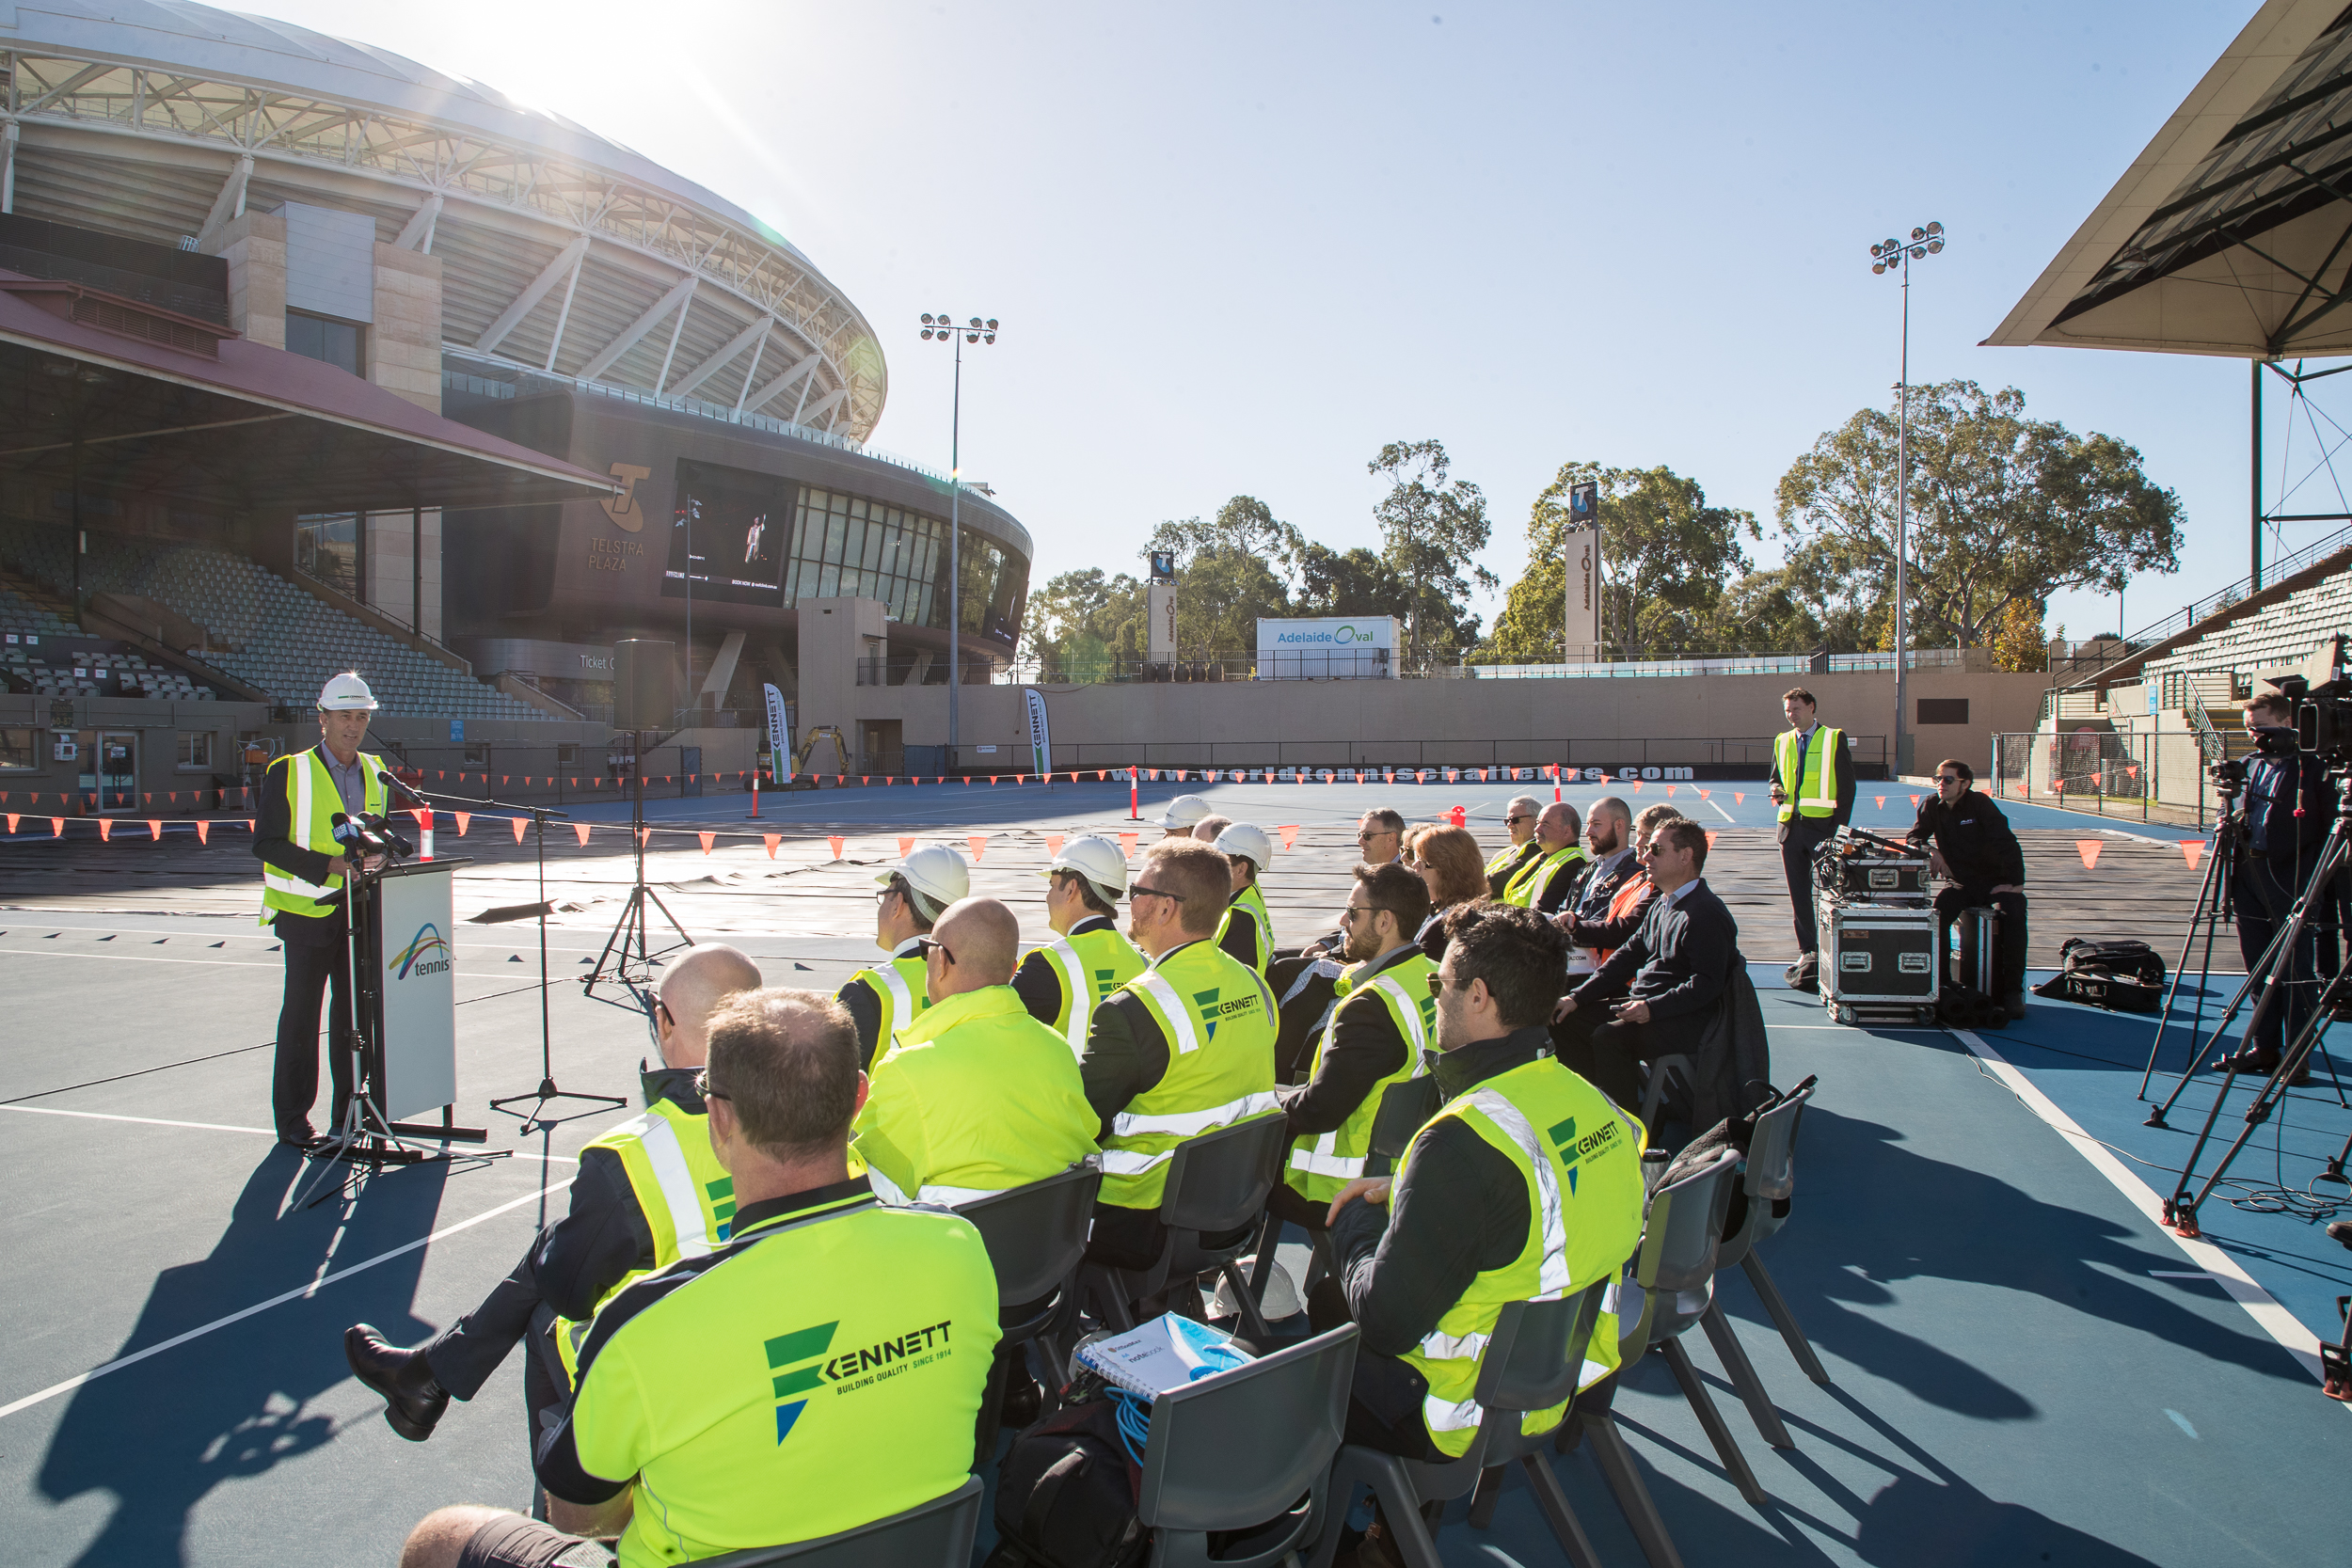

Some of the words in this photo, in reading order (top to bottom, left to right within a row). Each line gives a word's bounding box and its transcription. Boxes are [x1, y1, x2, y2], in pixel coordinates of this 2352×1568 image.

[591, 537, 644, 556] TELSTRA
[588, 555, 627, 572] PLAZA
[1581, 545, 1592, 572] Oval
[1166, 595, 1175, 615] Oval
[1277, 631, 1332, 643] Adelaide
[1333, 625, 1374, 644] Oval
[580, 655, 607, 670] Ticket
[767, 690, 780, 748] KENNETT
[1028, 694, 1041, 747] KENNETT
[415, 958, 450, 976] tennis
[1219, 994, 1258, 1014] KENNETT
[1578, 1120, 1619, 1155] KENNETT
[825, 1319, 951, 1381] KENNETT
[1129, 1346, 1165, 1363] notebook
[836, 1375, 875, 1396] BUILDING
[876, 1363, 909, 1382] QUALITY
[913, 1354, 934, 1369] SINCE
[935, 1348, 952, 1360] 1914
